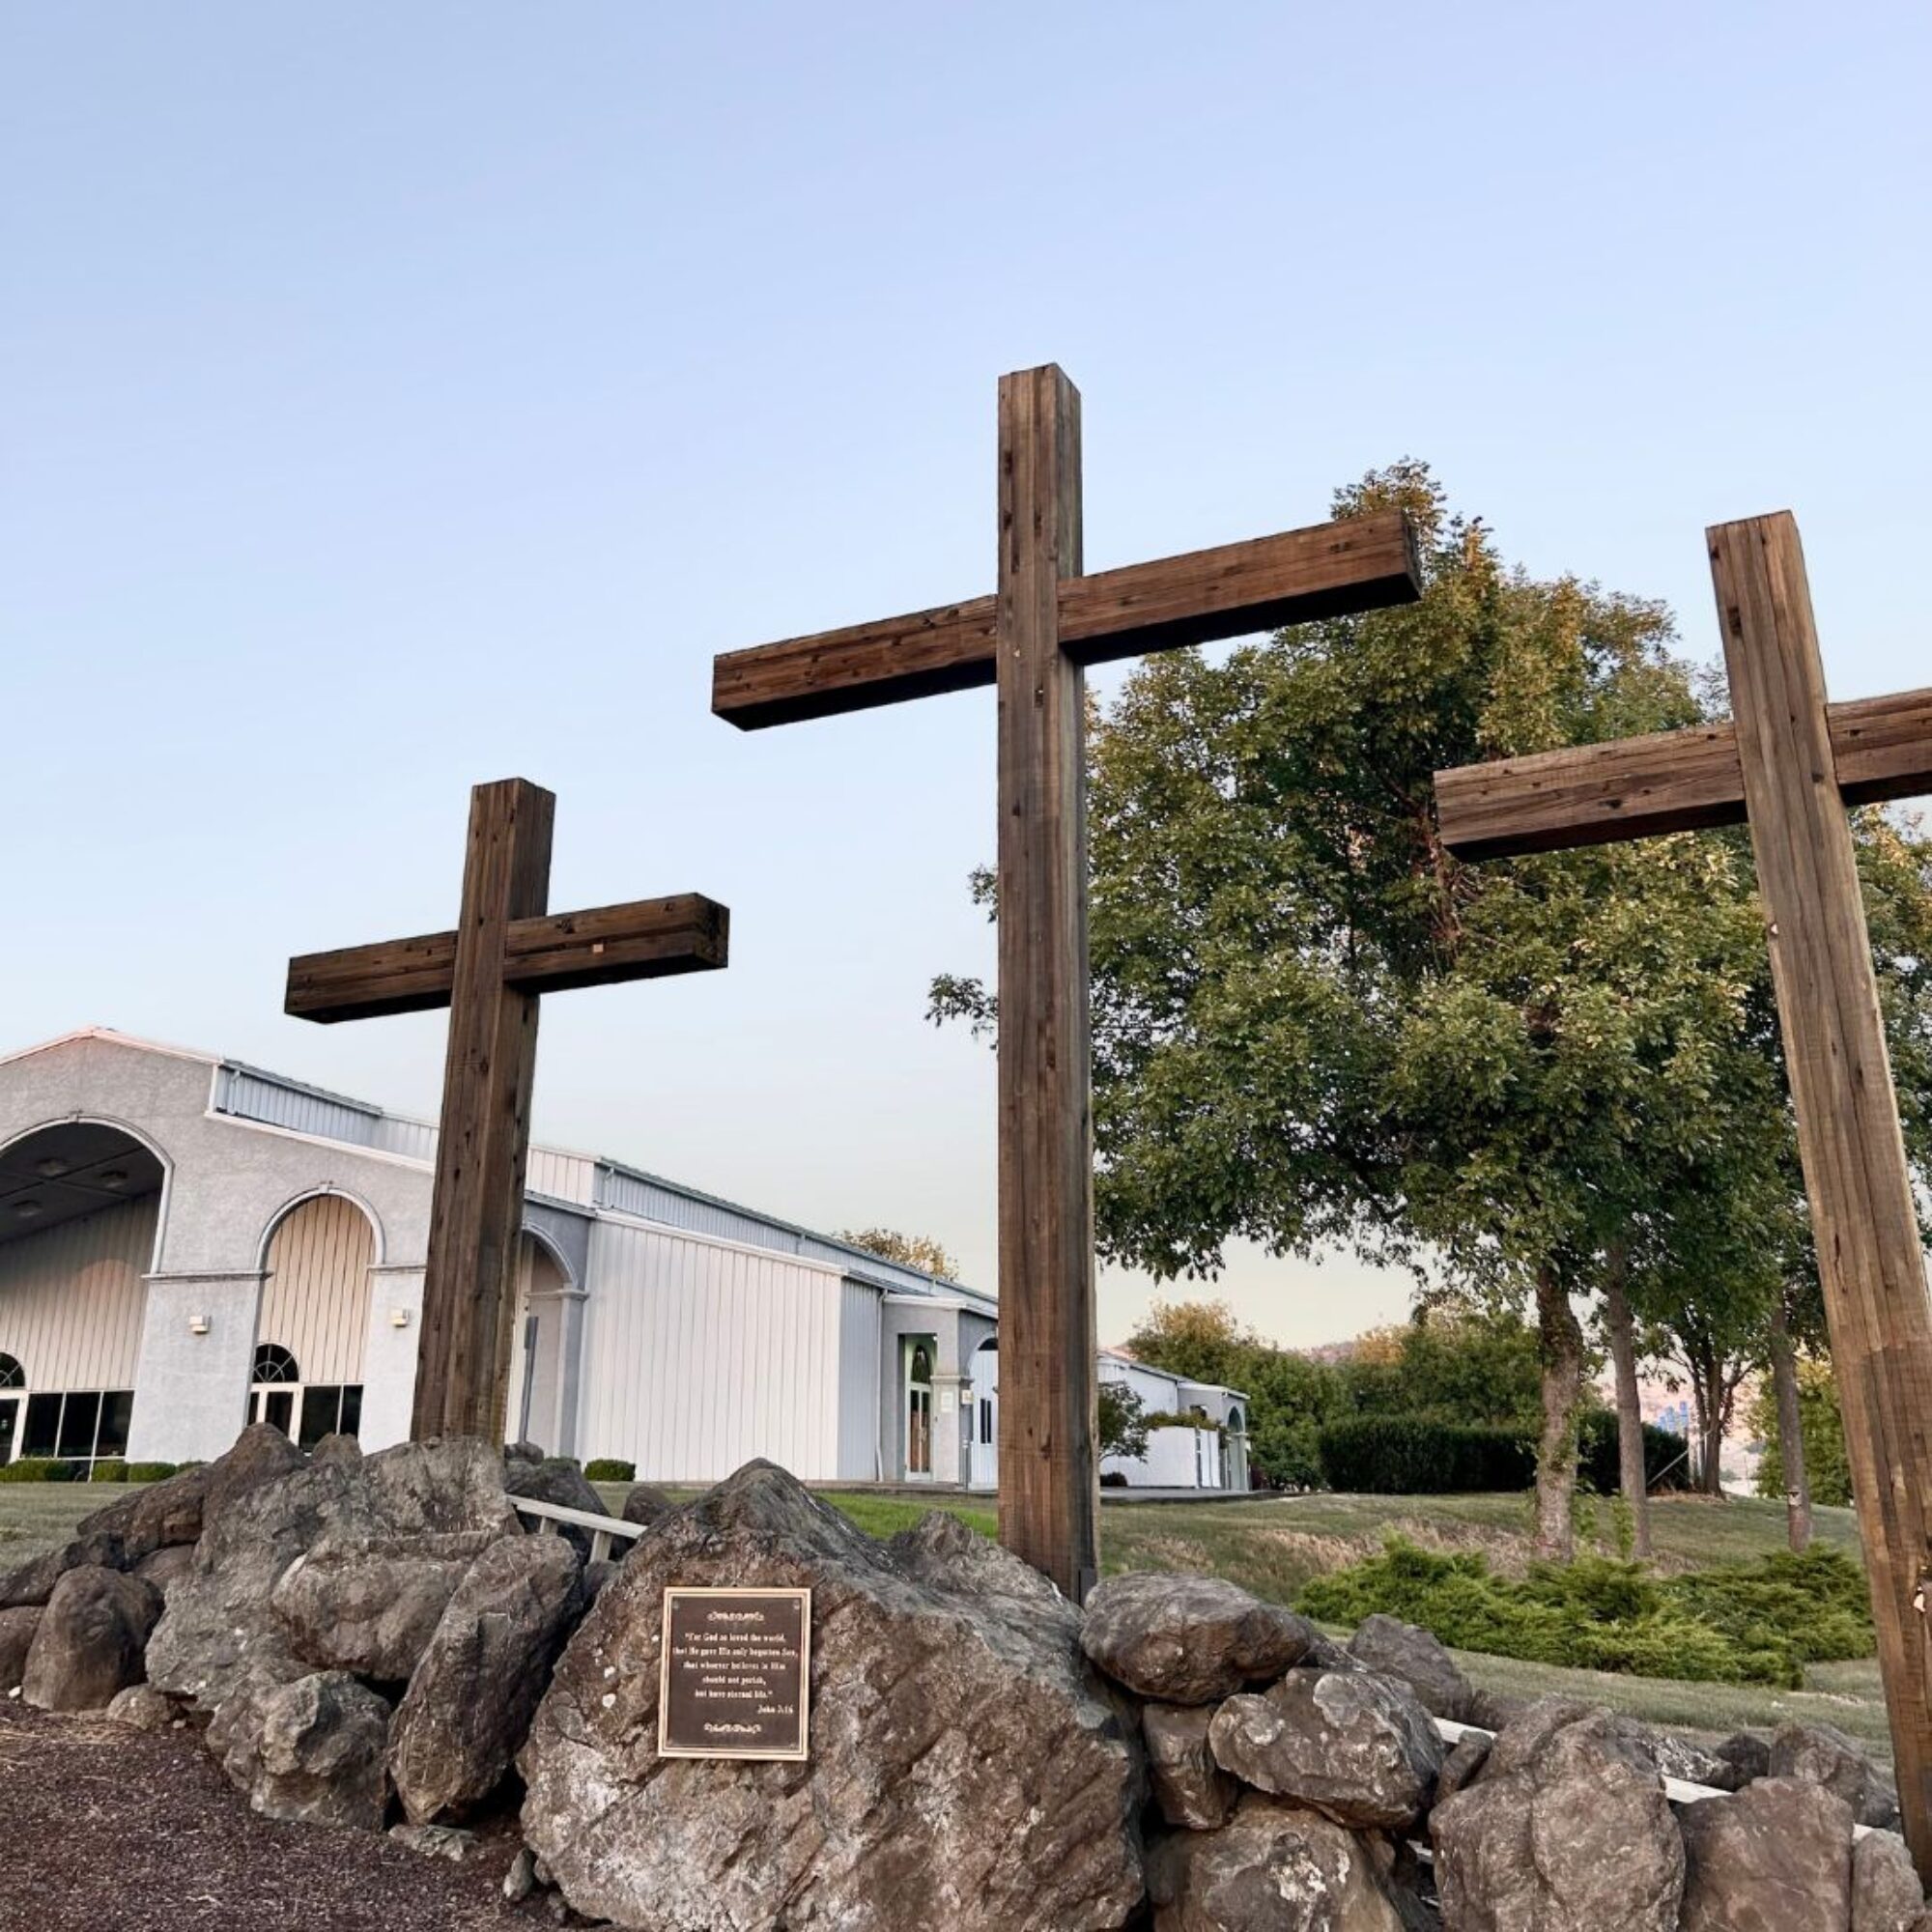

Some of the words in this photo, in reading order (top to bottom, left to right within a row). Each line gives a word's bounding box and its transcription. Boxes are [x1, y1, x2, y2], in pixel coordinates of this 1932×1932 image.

[703, 1633, 718, 1641] God
[729, 1633, 749, 1641] loved
[750, 1633, 761, 1641] the
[672, 1646, 687, 1655] that
[689, 1646, 698, 1655] He
[700, 1648, 717, 1657] gave
[732, 1647, 748, 1657] only
[750, 1647, 780, 1657] begotten
[683, 1661, 698, 1669] that
[730, 1661, 759, 1669] believes
[702, 1675, 725, 1684] should
[695, 1689, 707, 1697] but
[708, 1690, 725, 1698] have
[727, 1690, 753, 1698] eternal
[757, 1704, 776, 1714] John
